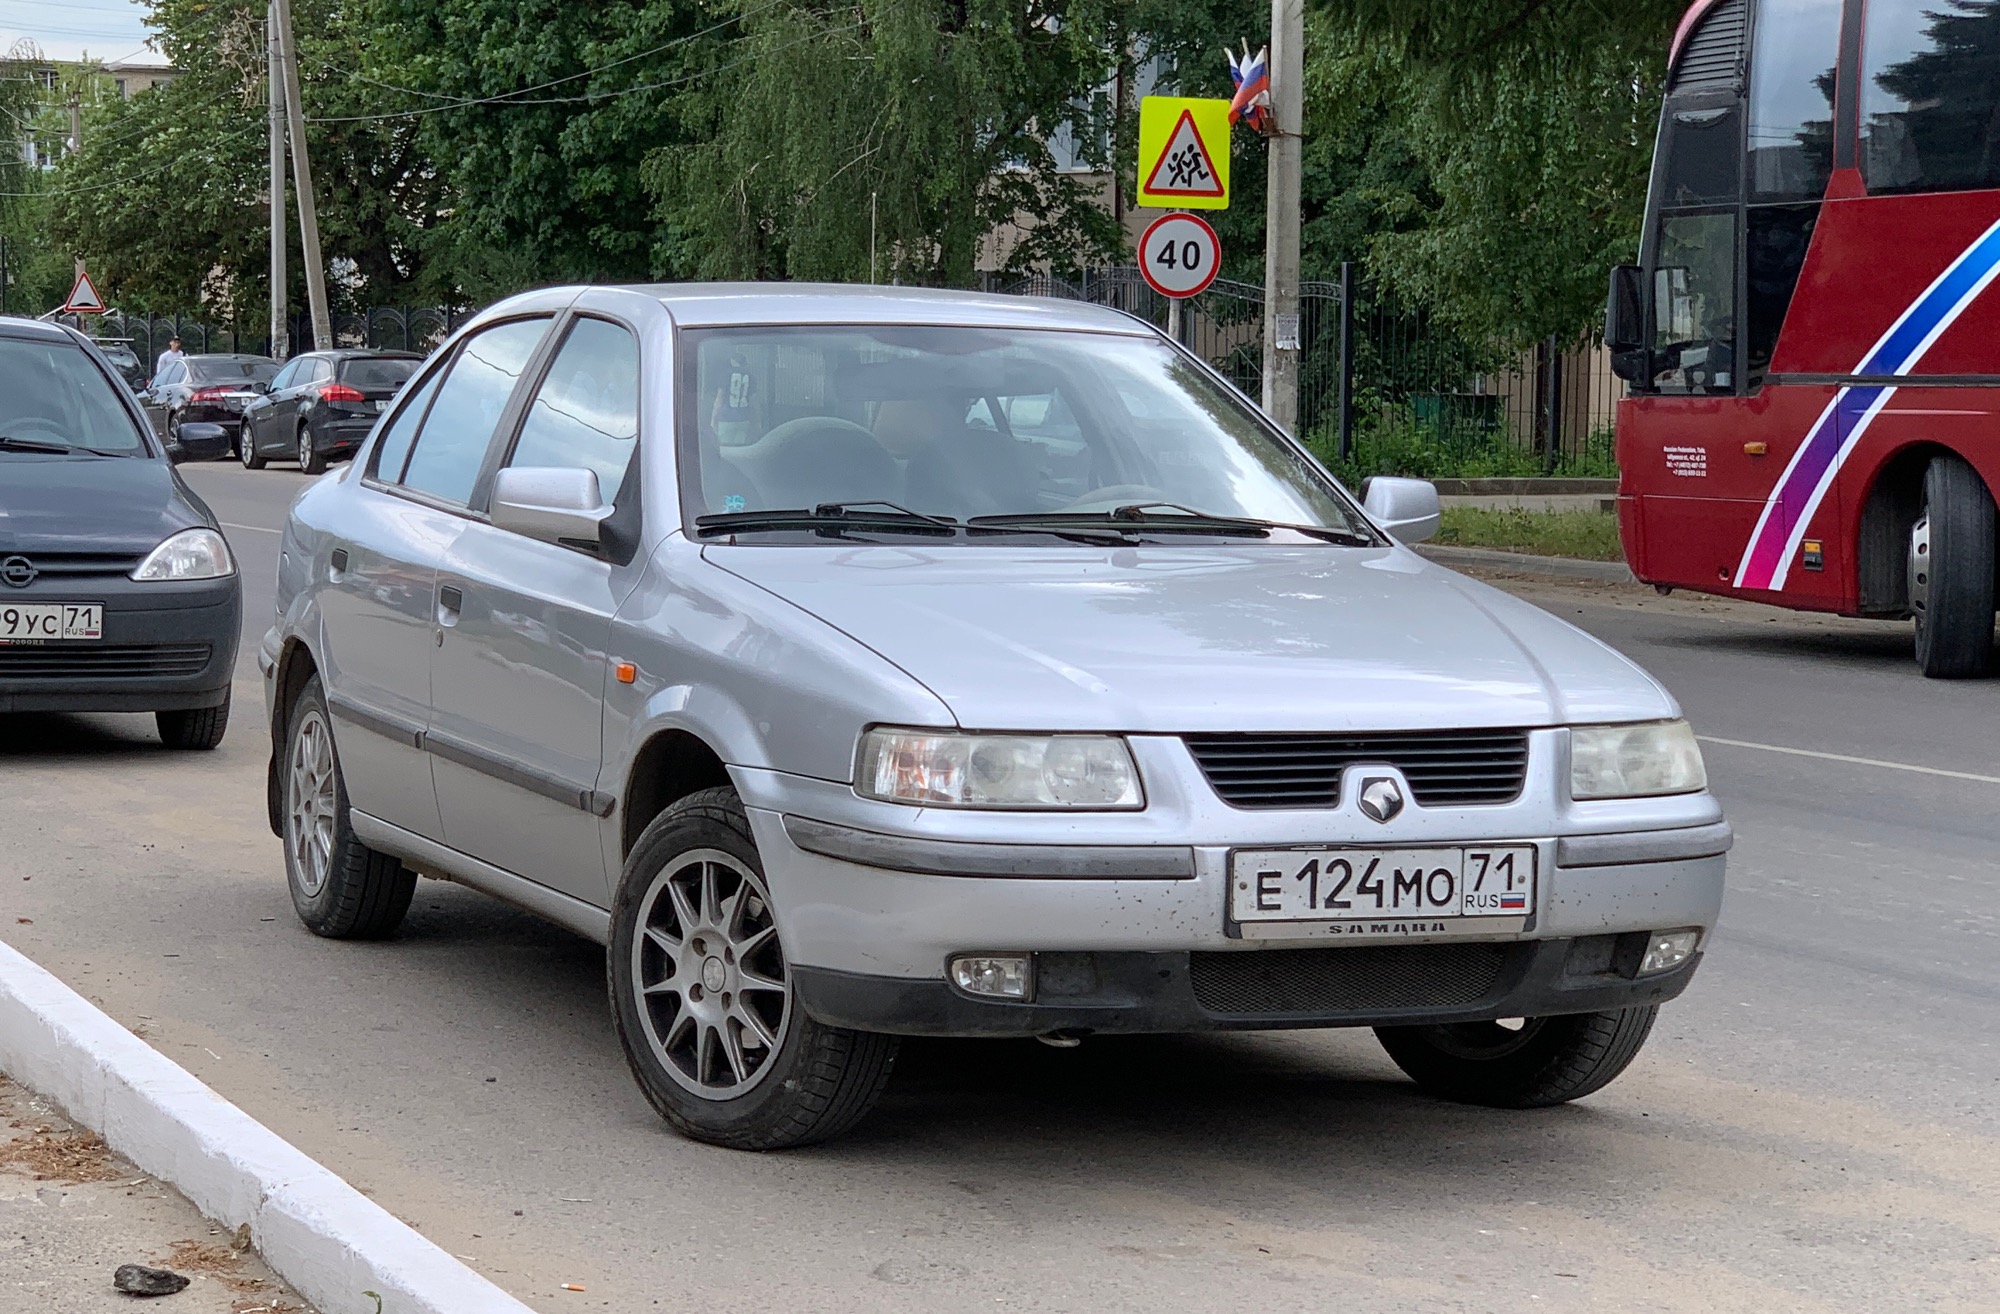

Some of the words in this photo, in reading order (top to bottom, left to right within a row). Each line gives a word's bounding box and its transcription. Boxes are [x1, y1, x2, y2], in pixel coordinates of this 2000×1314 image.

[1156, 239, 1201, 271] 40
[0, 608, 58, 634] 9YC
[66, 607, 92, 628] 71
[64, 627, 85, 636] RUS
[1470, 852, 1515, 892] 71
[1464, 893, 1499, 909] RUS
[1328, 922, 1446, 935] SAMARA
